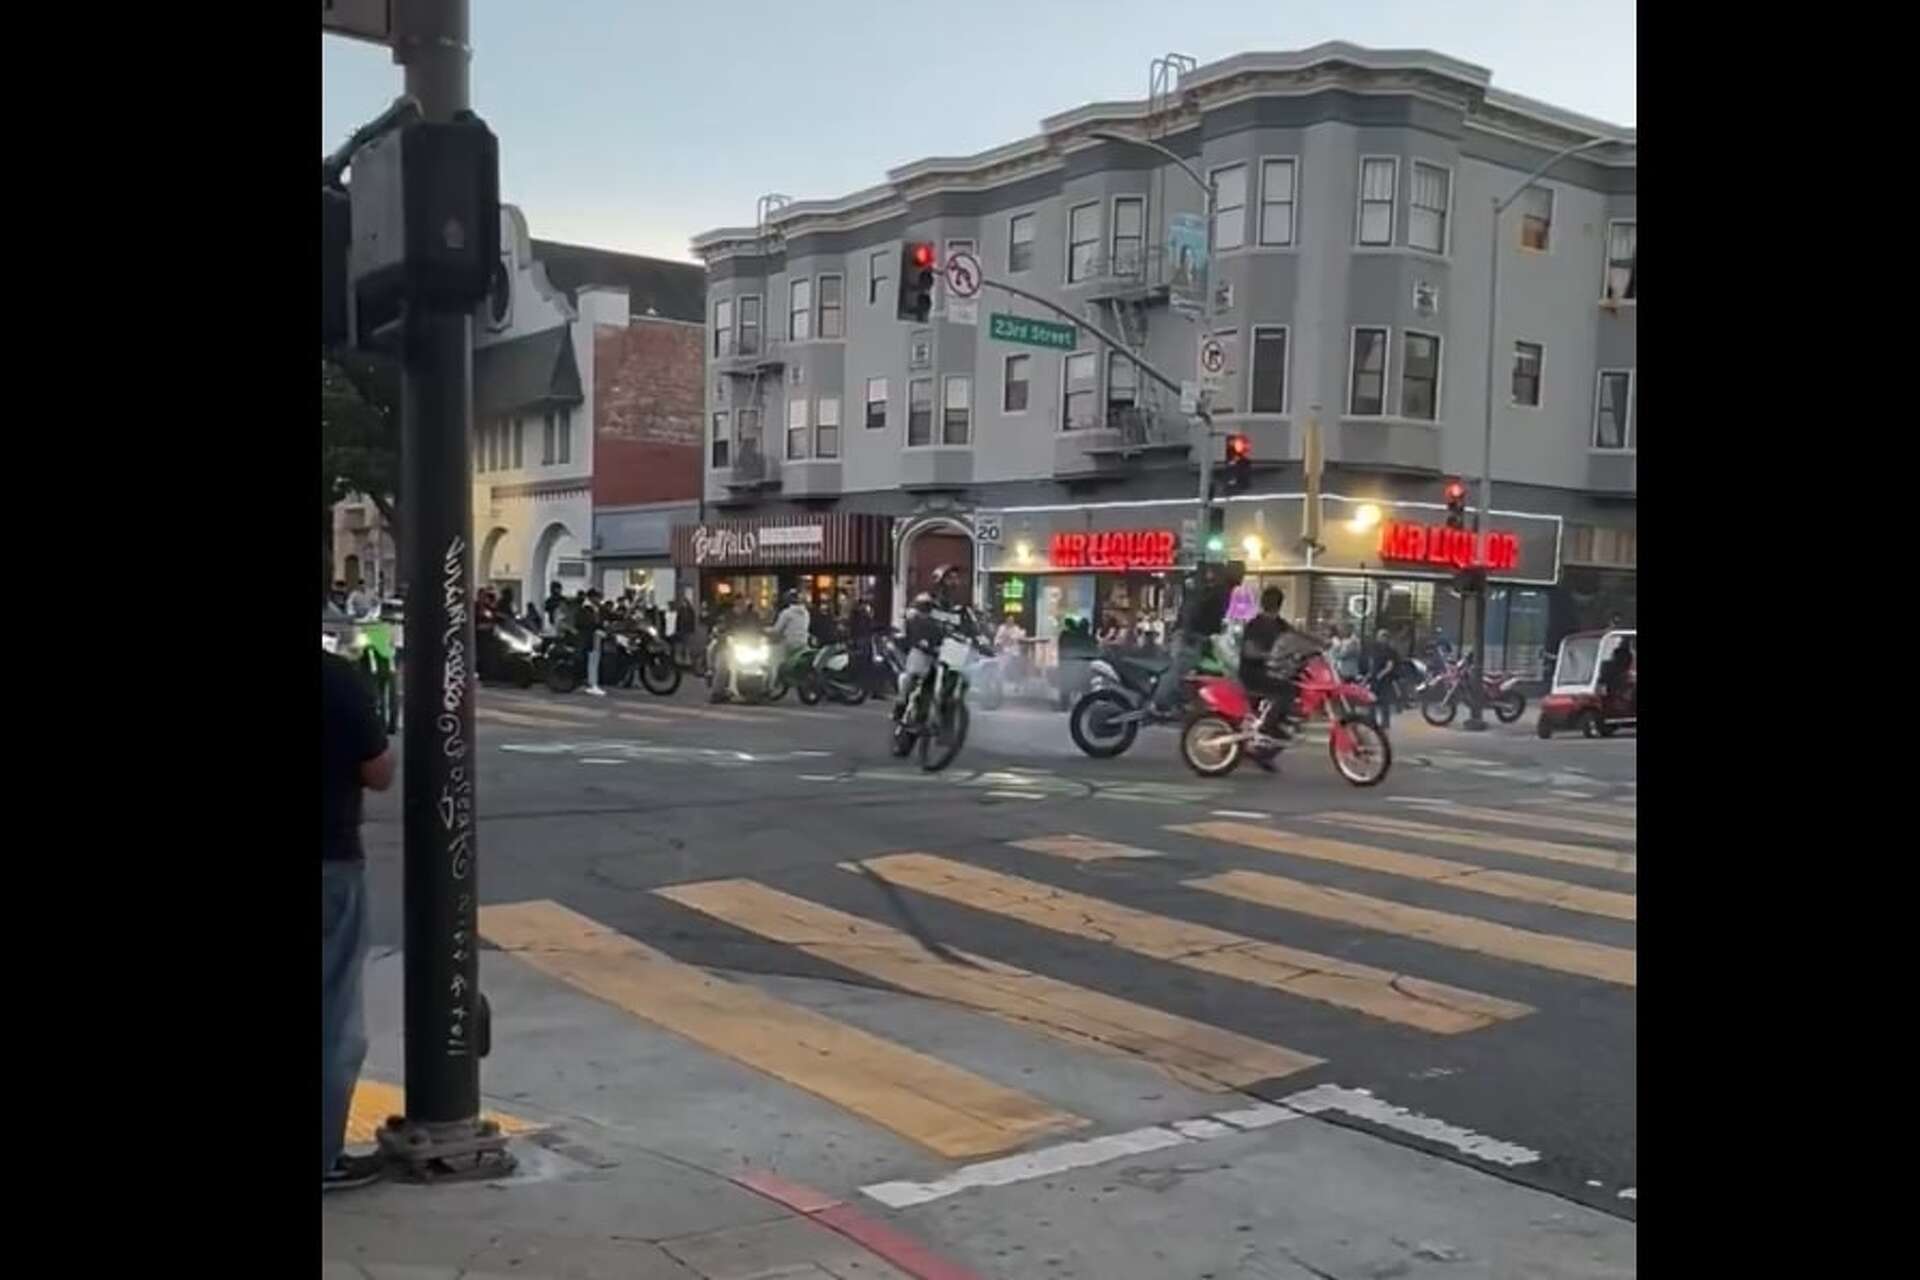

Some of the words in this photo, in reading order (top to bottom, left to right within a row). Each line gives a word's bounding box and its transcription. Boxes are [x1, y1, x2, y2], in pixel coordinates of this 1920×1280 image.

[995, 318, 1028, 339] 23rd
[1031, 325, 1072, 345] Street
[978, 525, 1000, 541] 20
[1052, 531, 1086, 567] MR
[1088, 530, 1176, 568] LIQUOR
[1382, 522, 1426, 561] MR
